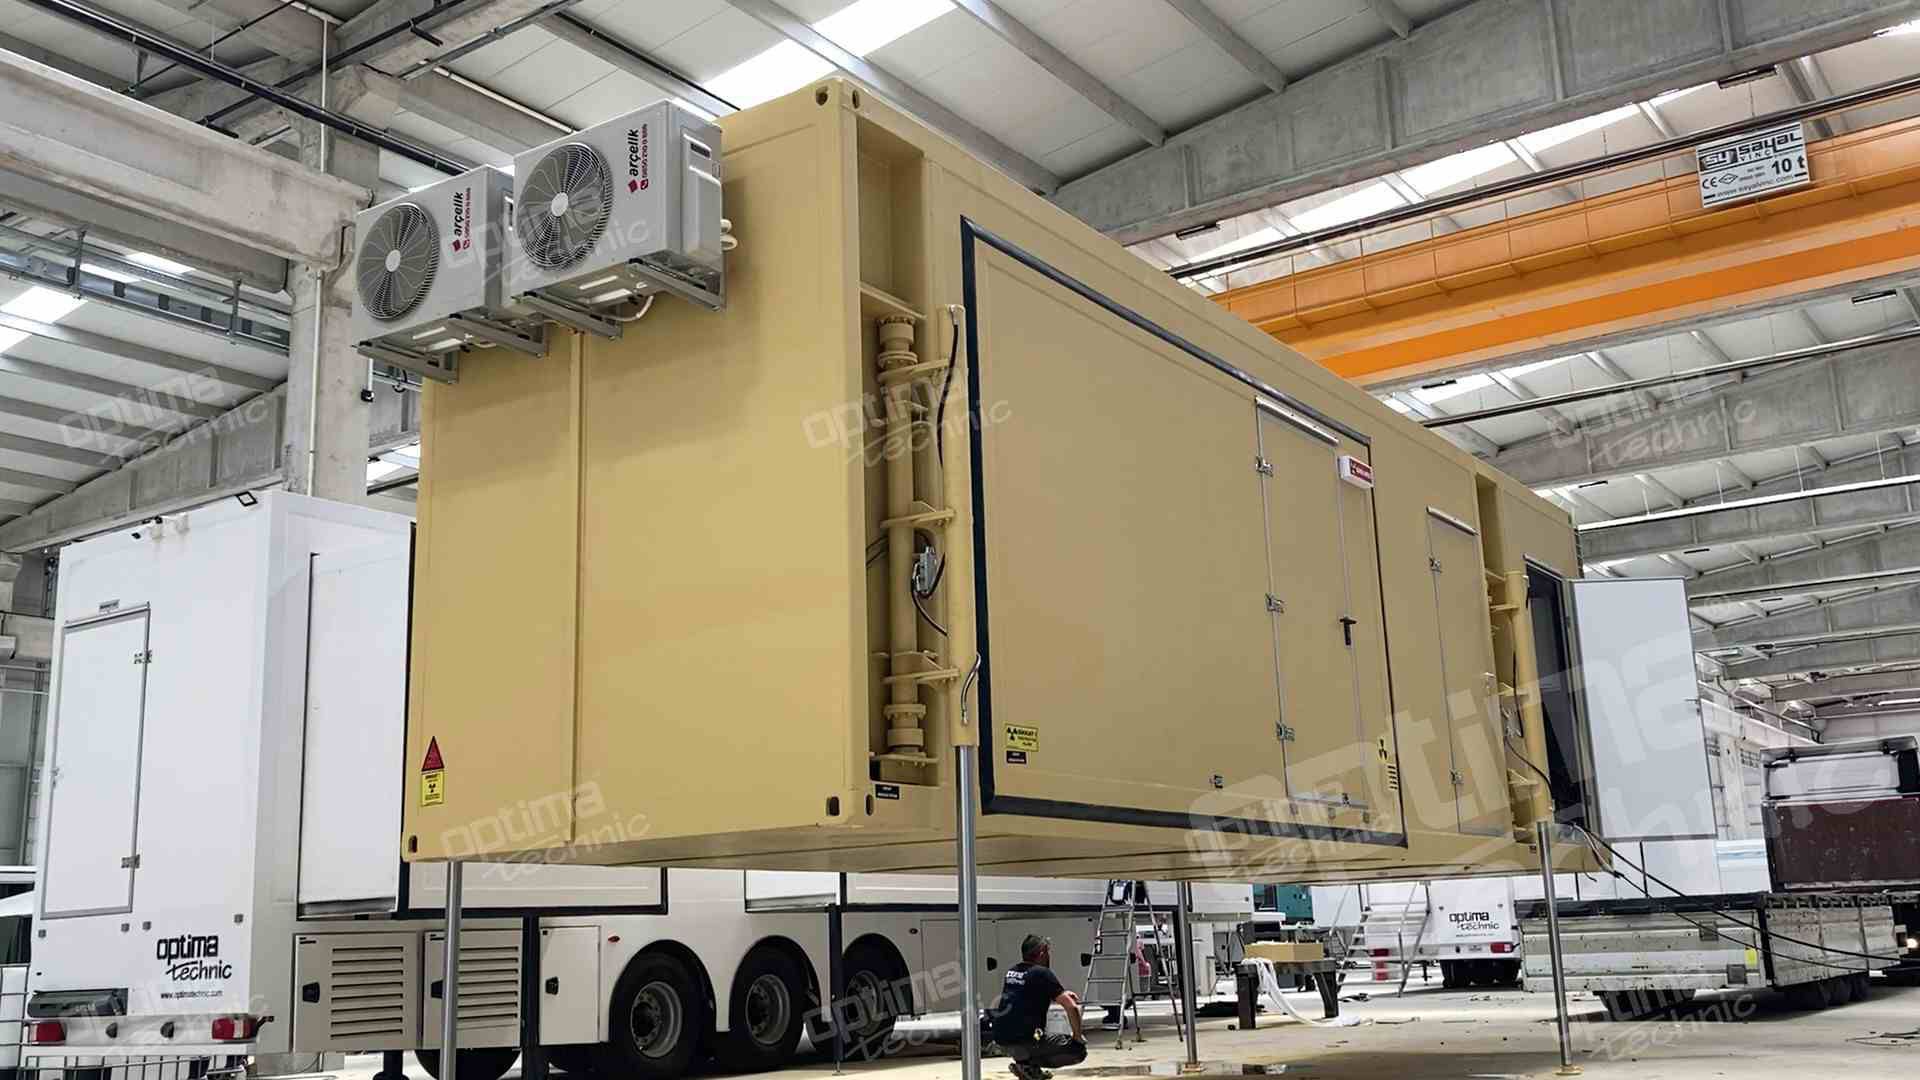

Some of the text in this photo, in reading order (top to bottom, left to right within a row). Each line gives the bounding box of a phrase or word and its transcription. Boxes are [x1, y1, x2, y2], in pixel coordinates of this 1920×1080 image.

[1772, 158, 1792, 174] 10
[1797, 155, 1805, 168] t
[1449, 912, 1489, 923] optima
[157, 934, 218, 966] optima
[166, 960, 232, 981] technic
